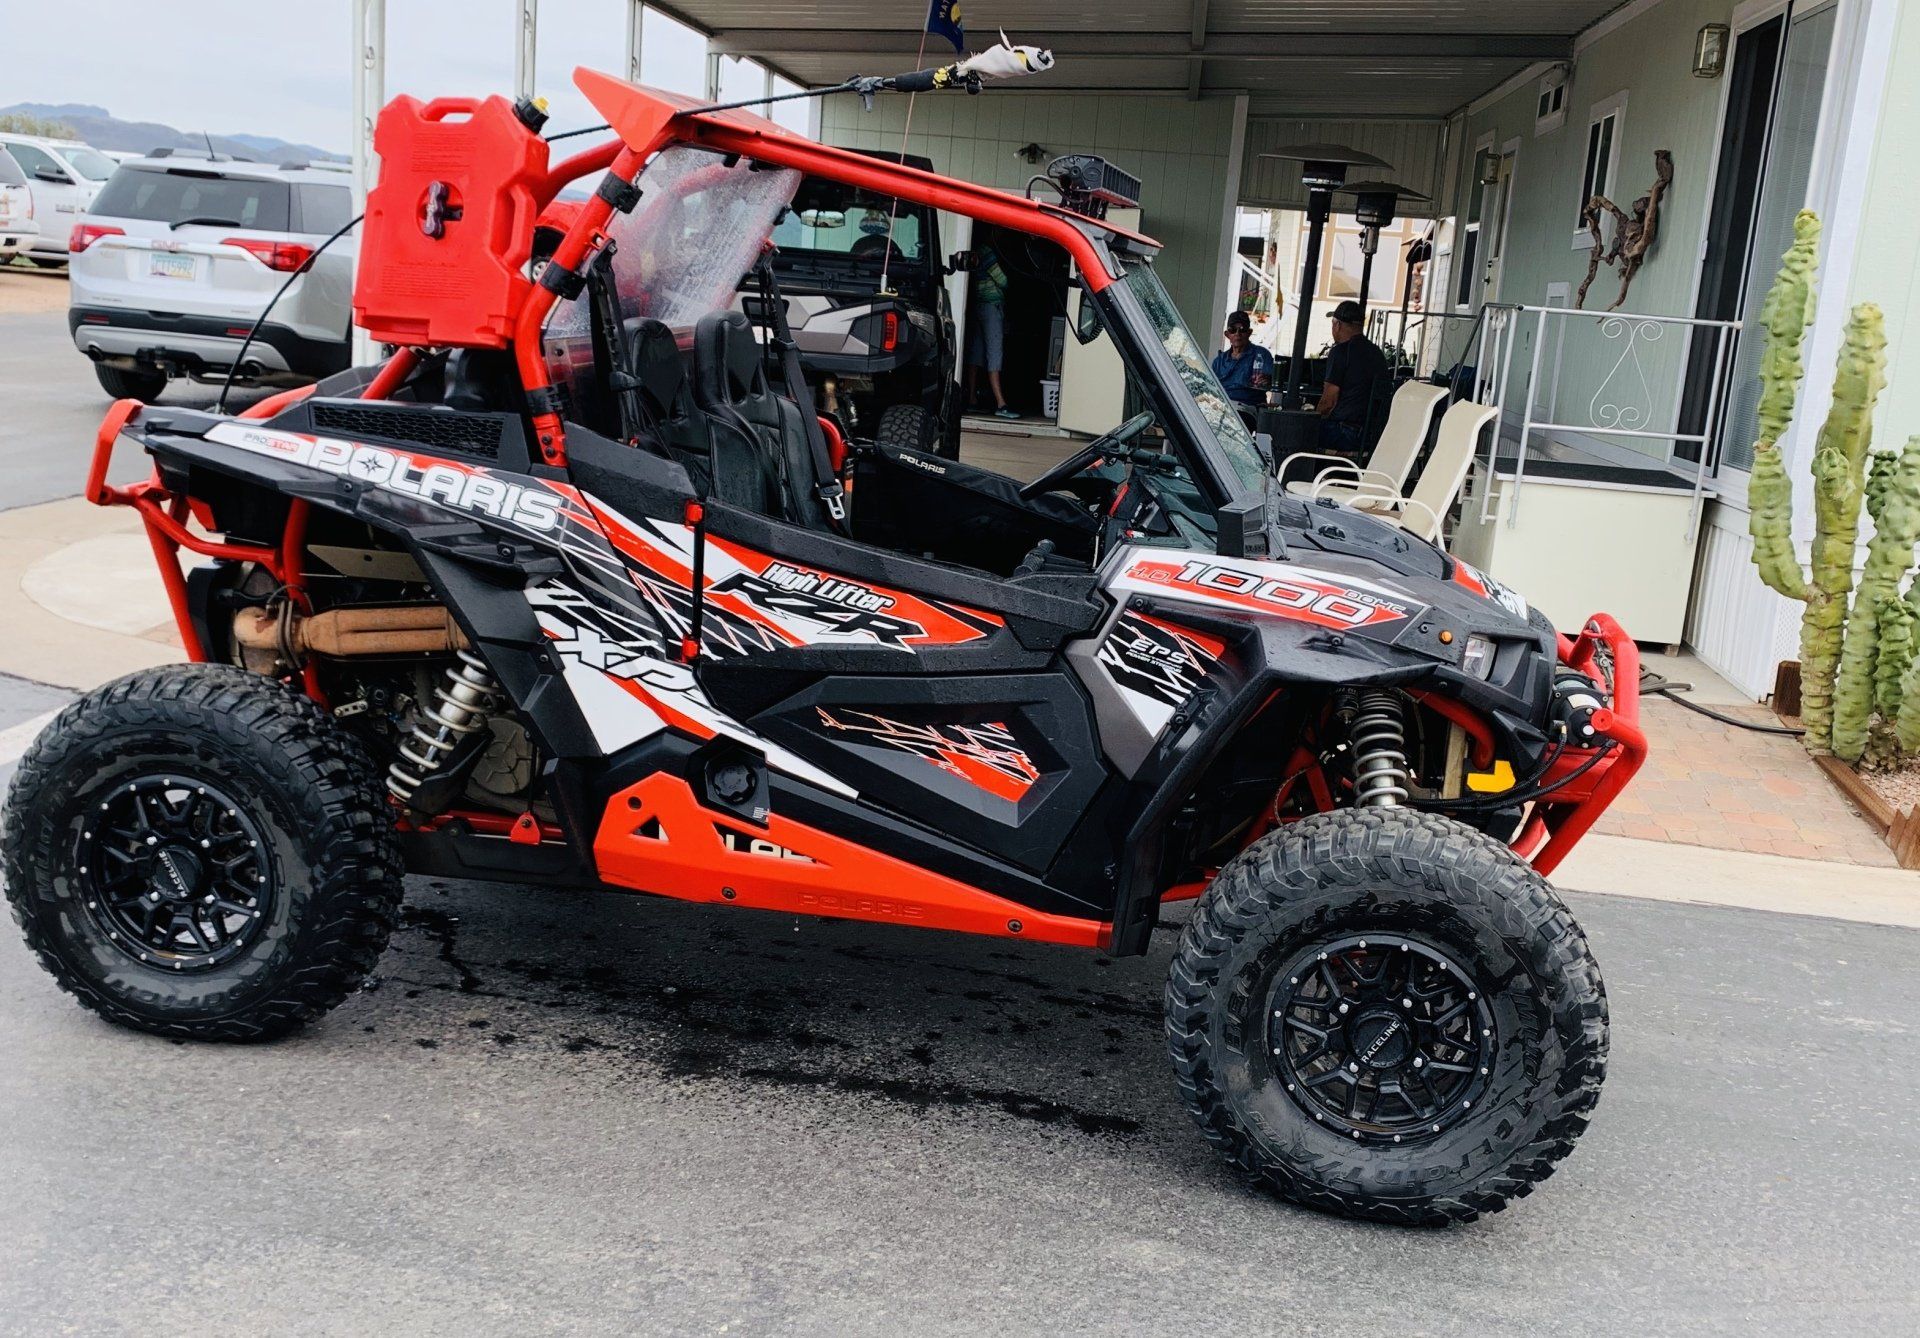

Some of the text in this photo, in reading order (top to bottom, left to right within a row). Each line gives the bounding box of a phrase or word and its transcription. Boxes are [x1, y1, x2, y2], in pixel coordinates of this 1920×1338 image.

[307, 437, 564, 531] POLARIS
[899, 453, 946, 475] POLARIS
[761, 562, 896, 613] High Lifter
[1175, 560, 1376, 625] 1000
[1344, 589, 1408, 614] DOHC
[704, 570, 930, 654] RZR
[1130, 639, 1189, 664] EPS
[799, 892, 924, 919] POLARIS
[1361, 1020, 1400, 1063] RACELINE
